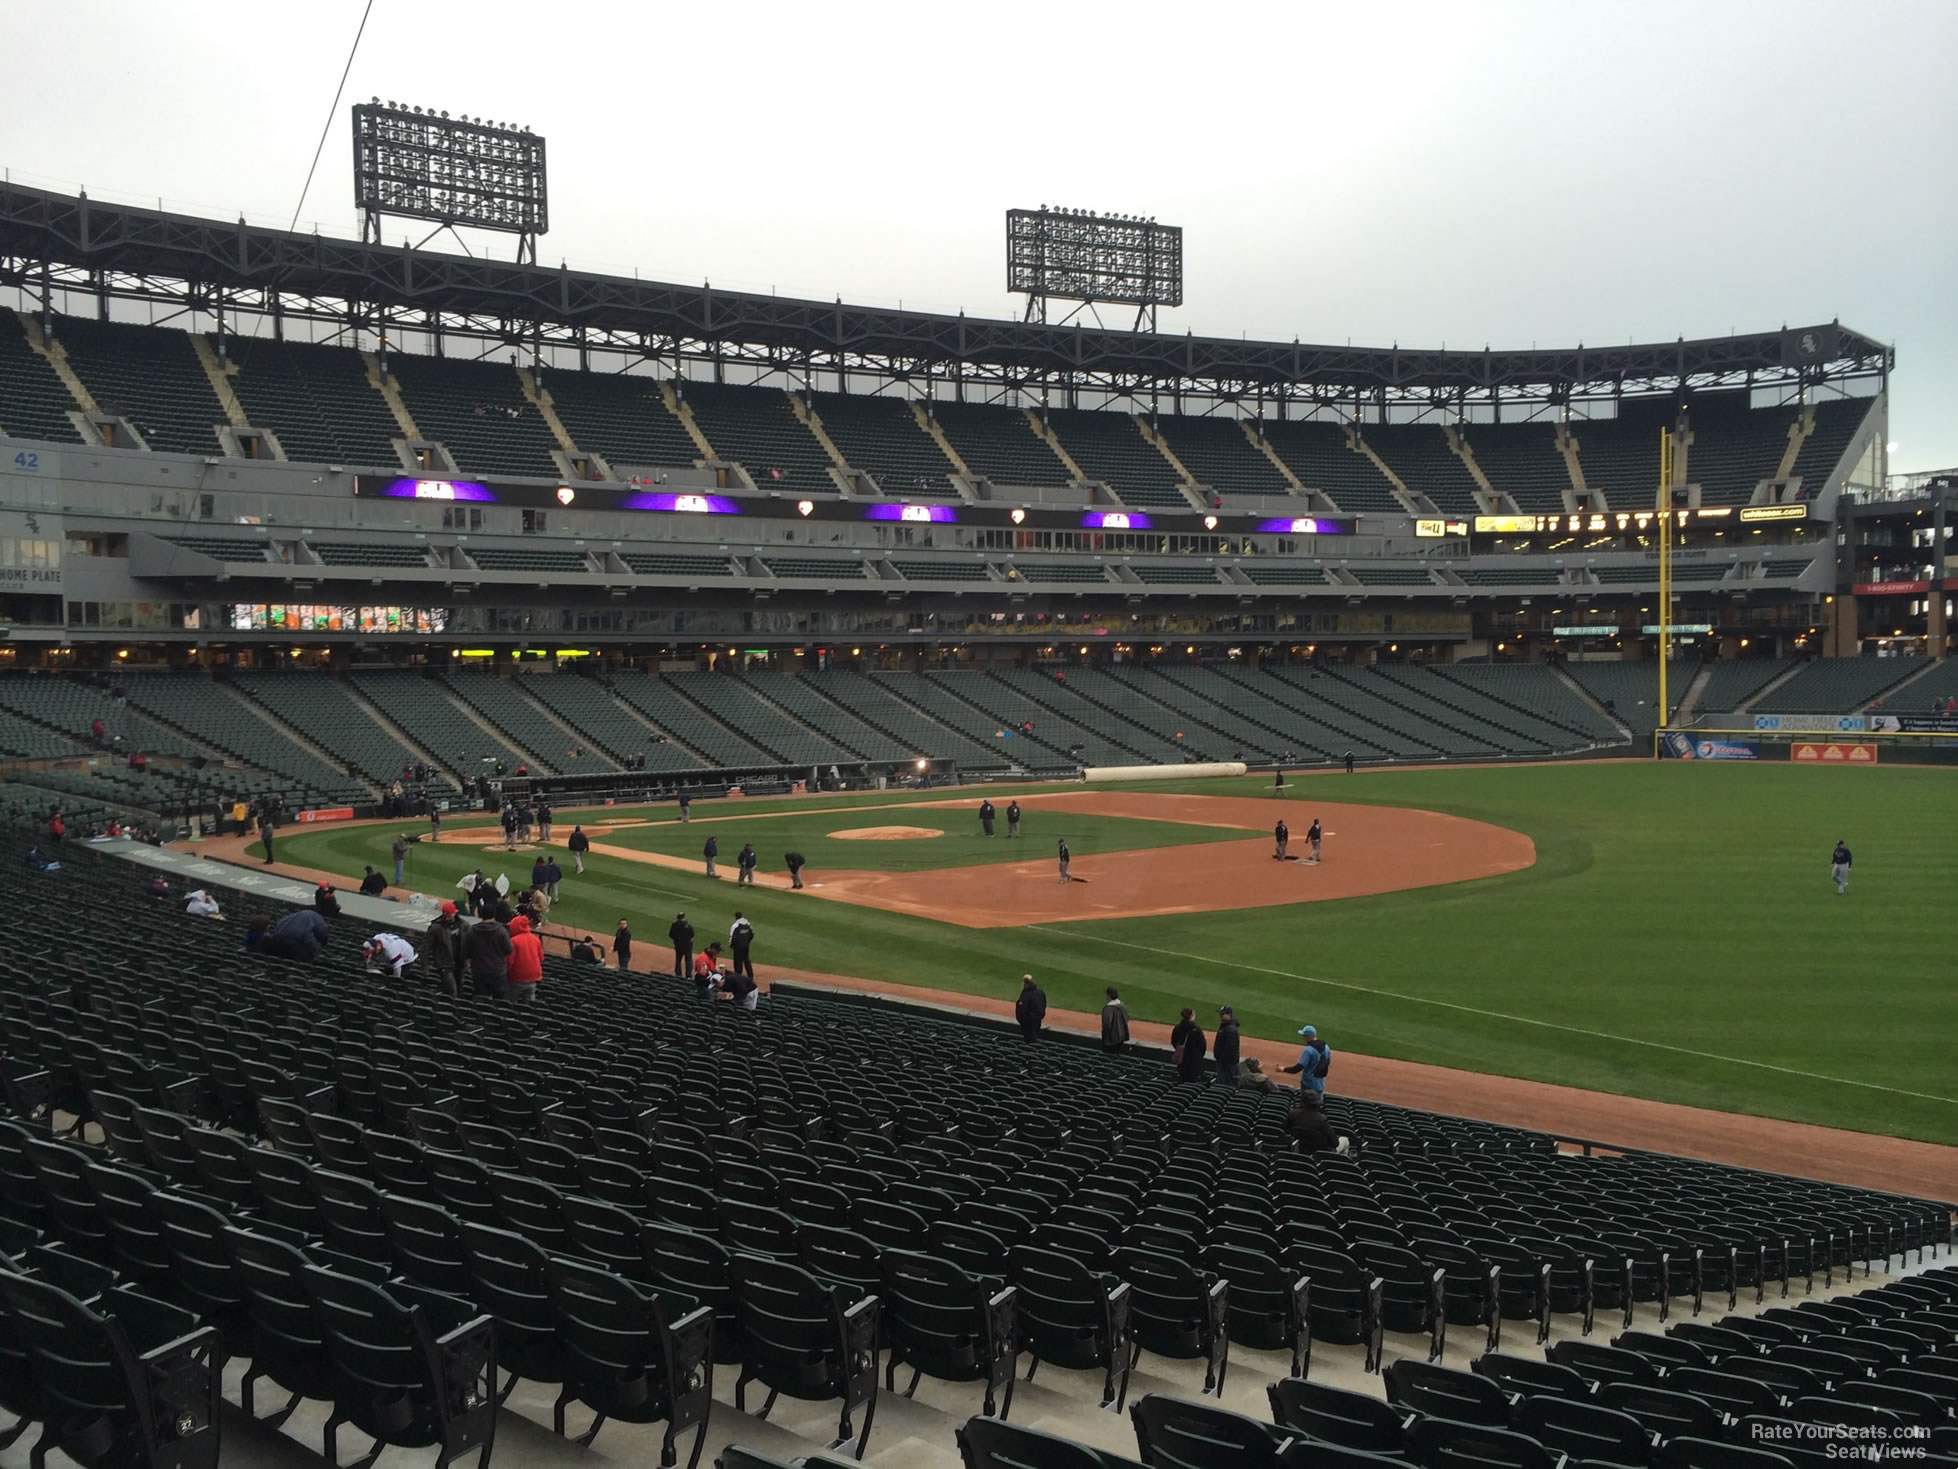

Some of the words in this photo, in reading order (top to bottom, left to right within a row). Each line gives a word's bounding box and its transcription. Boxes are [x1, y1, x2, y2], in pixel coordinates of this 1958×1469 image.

[14, 452, 39, 468] 42
[0, 569, 28, 581] HOME
[32, 570, 61, 583] PLATE
[1719, 747, 1753, 755] TOTAL
